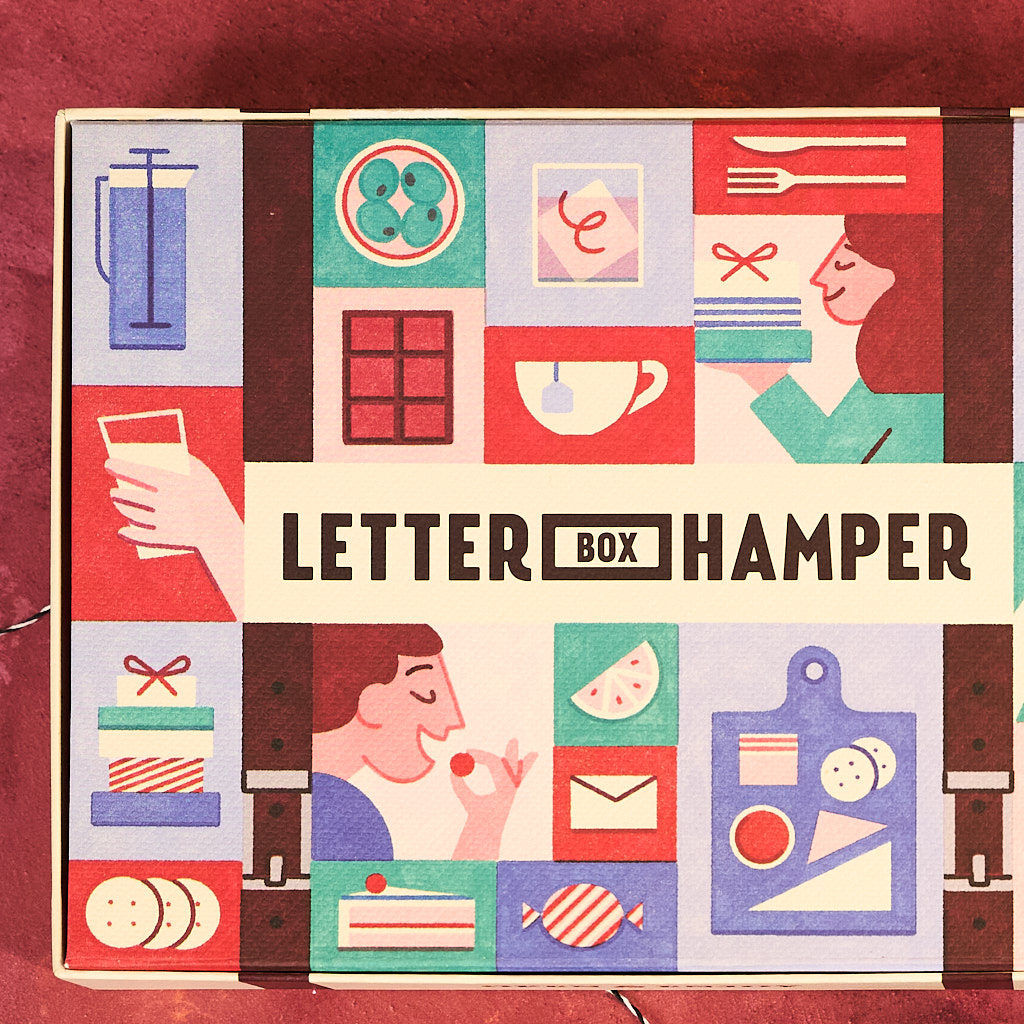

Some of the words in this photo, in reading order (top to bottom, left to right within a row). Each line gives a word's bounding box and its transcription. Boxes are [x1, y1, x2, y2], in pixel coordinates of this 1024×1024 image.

[282, 512, 532, 582] LETTER
[576, 531, 638, 563] BOX
[683, 512, 972, 582] HAMPER
